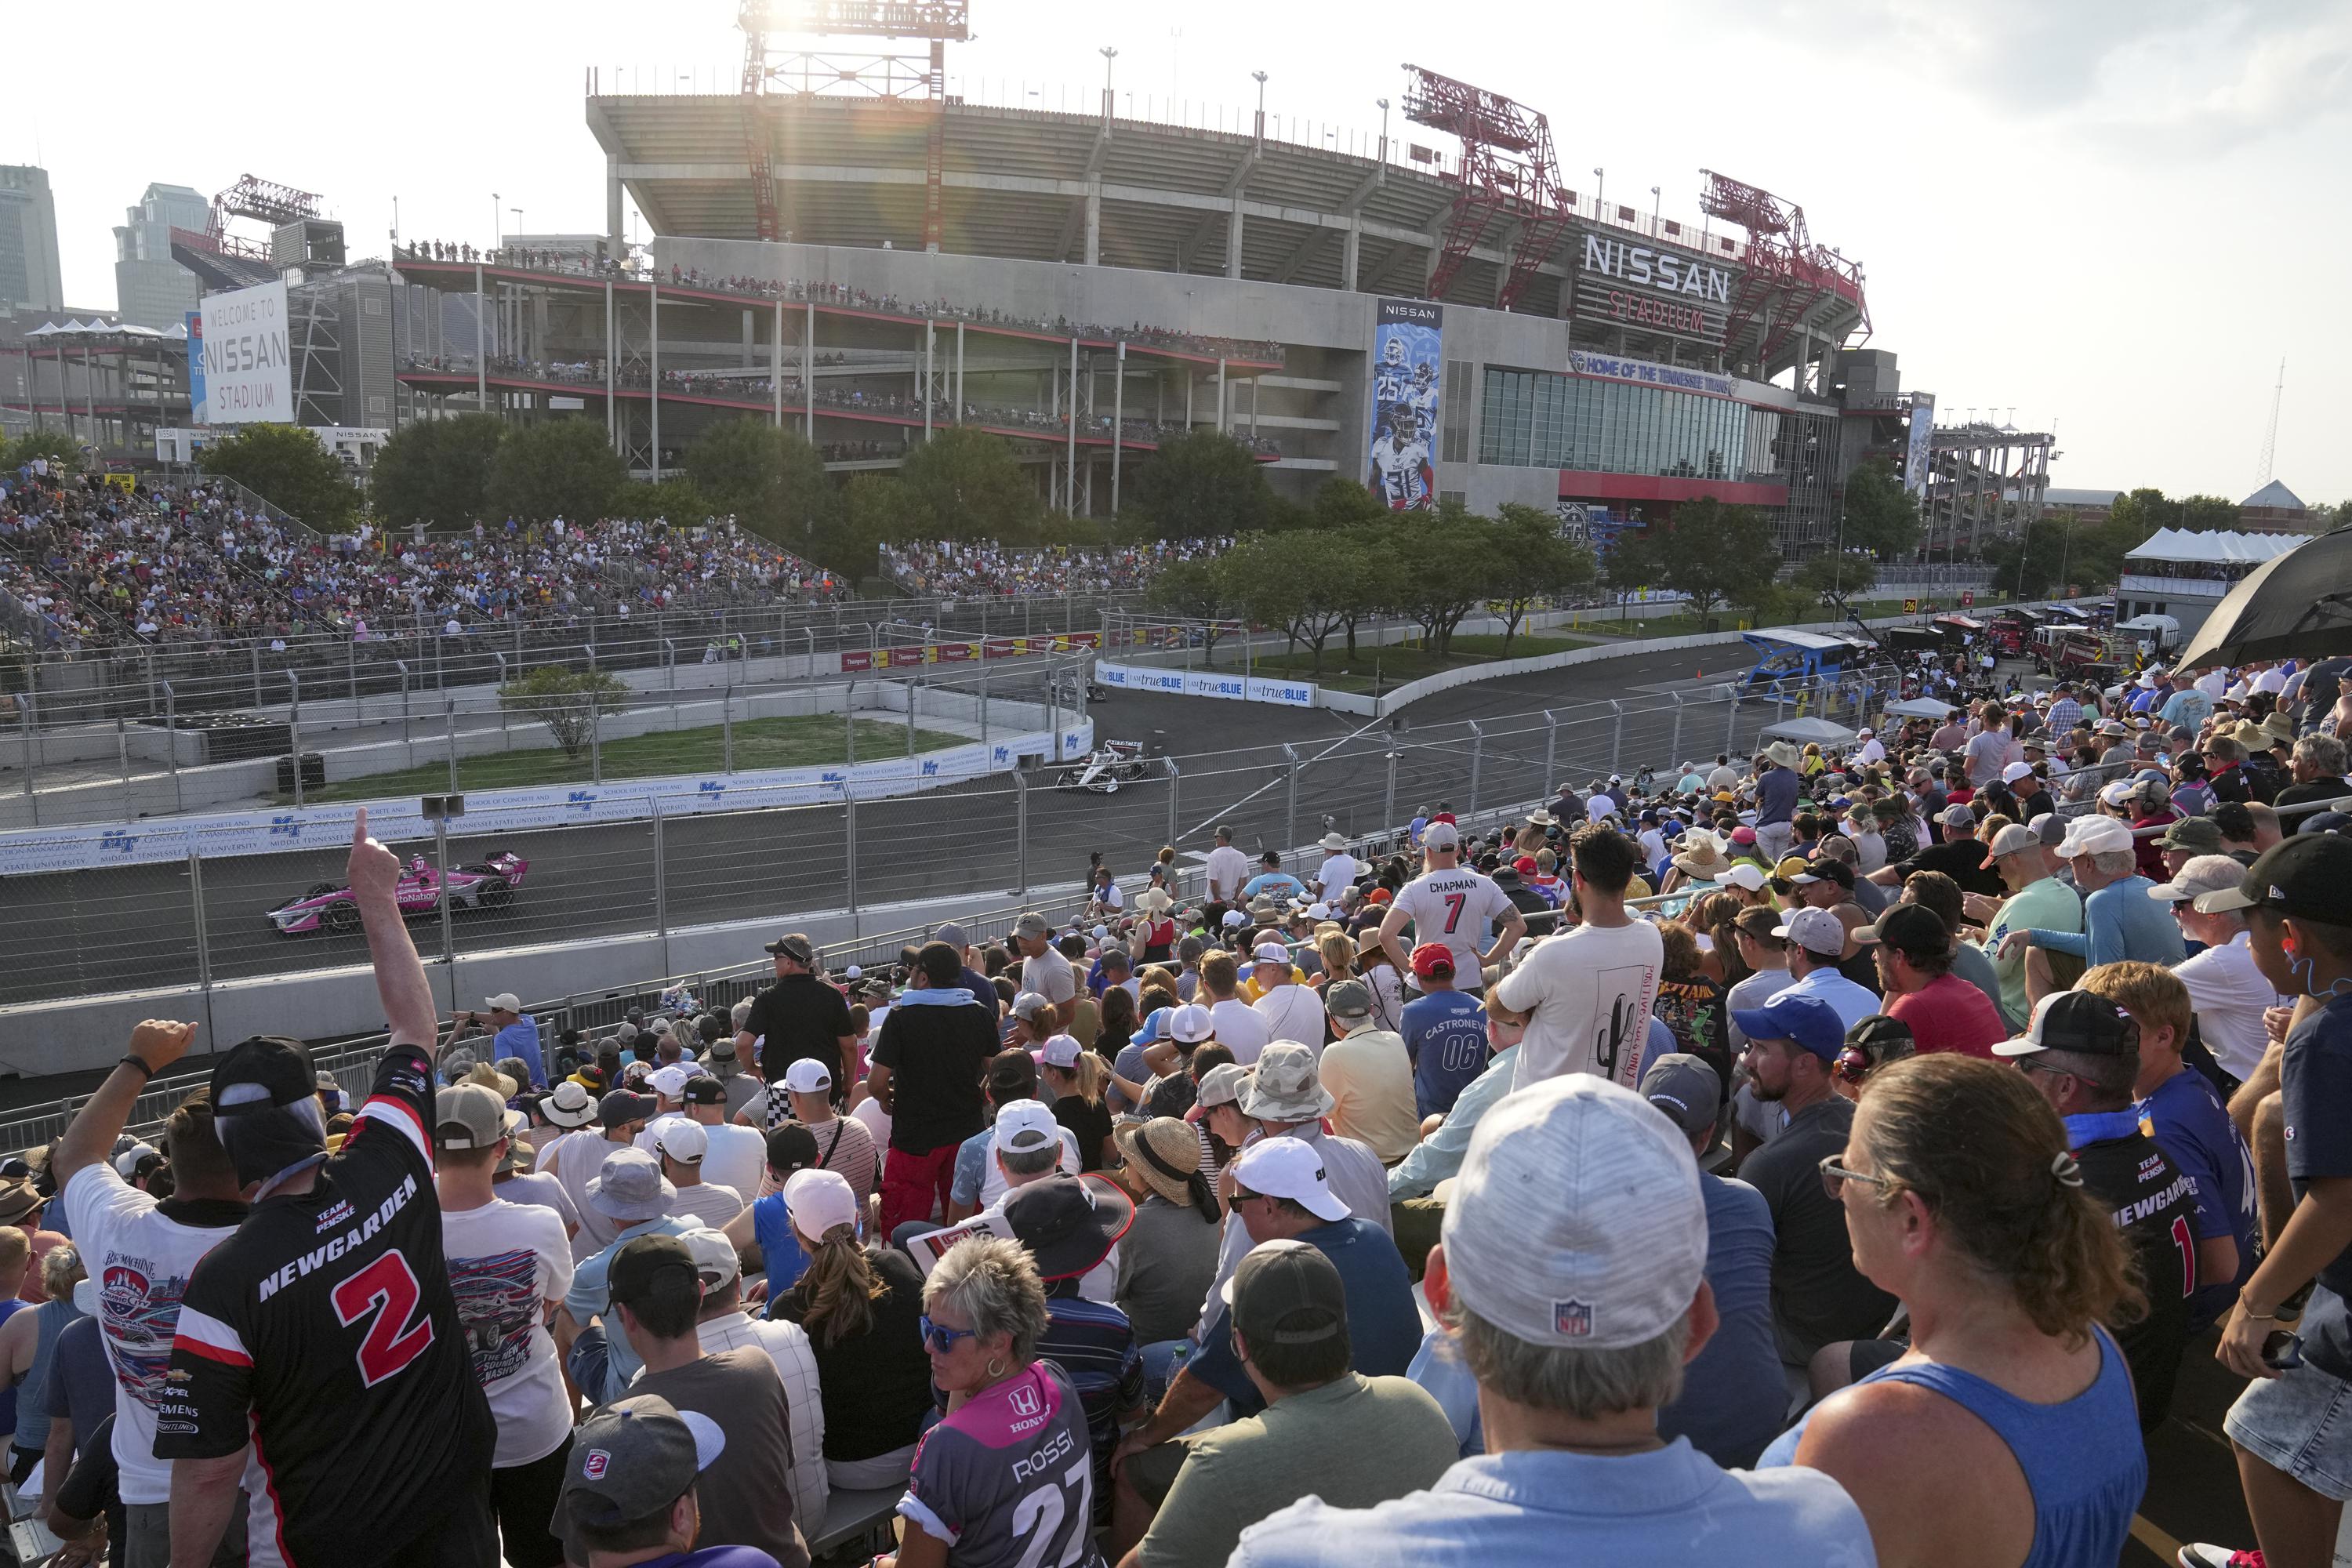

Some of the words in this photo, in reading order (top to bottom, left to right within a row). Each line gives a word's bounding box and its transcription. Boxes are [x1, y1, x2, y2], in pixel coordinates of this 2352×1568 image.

[1585, 234, 1729, 303] NISSAN
[210, 302, 256, 328] WELCOME
[263, 298, 274, 319] TO
[1386, 305, 1435, 319] NISSAN
[1608, 290, 1704, 334] STADIUM
[205, 330, 286, 375] NISSAN
[1586, 358, 1619, 376] HOME
[1621, 363, 1636, 379] OF
[1639, 365, 1657, 382] THE
[1658, 368, 1704, 390] TENNESSEE
[1704, 376, 1729, 394] TITANS
[220, 383, 274, 409] STADIUM
[1904, 601, 1915, 612] 26
[1141, 673, 1181, 688] trueBLUE
[1199, 679, 1242, 695] trueBLUE
[1261, 684, 1308, 702] trueBLUE
[724, 798, 755, 807] TENNESSEE
[595, 808, 628, 817] TENNESSEE
[456, 821, 493, 829] TENNESSEE
[516, 815, 555, 824] UNIVERSITY
[270, 839, 300, 848] MIDDLE
[304, 835, 343, 844] TENNESSEE
[371, 829, 412, 837] UNIVERSITY
[27, 844, 84, 855] MANAGEMENT
[100, 854, 134, 863] MIDDLE
[138, 849, 181, 859] TENNESSEE
[211, 842, 257, 852] UNIVERSITY
[4, 862, 31, 871] STATE
[34, 859, 85, 869] UNIVERSITY
[416, 860, 424, 869] 27
[510, 872, 523, 884] 27
[1429, 878, 1477, 893] CHAPMAN
[396, 892, 436, 903] utoNation
[1444, 893, 1467, 934] 7
[1425, 1018, 1488, 1040] CASTRONEVE
[1443, 1033, 1479, 1072] 06
[1649, 1094, 1688, 1112] INAUGURAL
[2138, 1153, 2159, 1171] TEAM
[2137, 1161, 2166, 1183] PENSKE
[317, 1199, 347, 1221] TEAM
[316, 1205, 356, 1234] PENSKE
[260, 1173, 417, 1304] NEWGARDEN
[103, 1250, 118, 1266] BIG
[119, 1253, 157, 1279] MACHINE
[103, 1292, 127, 1304] MUSIC
[128, 1296, 149, 1307] CITY
[330, 1248, 436, 1389] 2
[1558, 1316, 1588, 1334] NFL
[483, 1353, 501, 1362] THE
[502, 1342, 519, 1360] NEW
[483, 1357, 514, 1371] SOUND
[516, 1349, 526, 1363] OF
[165, 1386, 189, 1397] XPEL
[1011, 1428, 1075, 1483] ROSSI
[1012, 1448, 1092, 1568] 27
